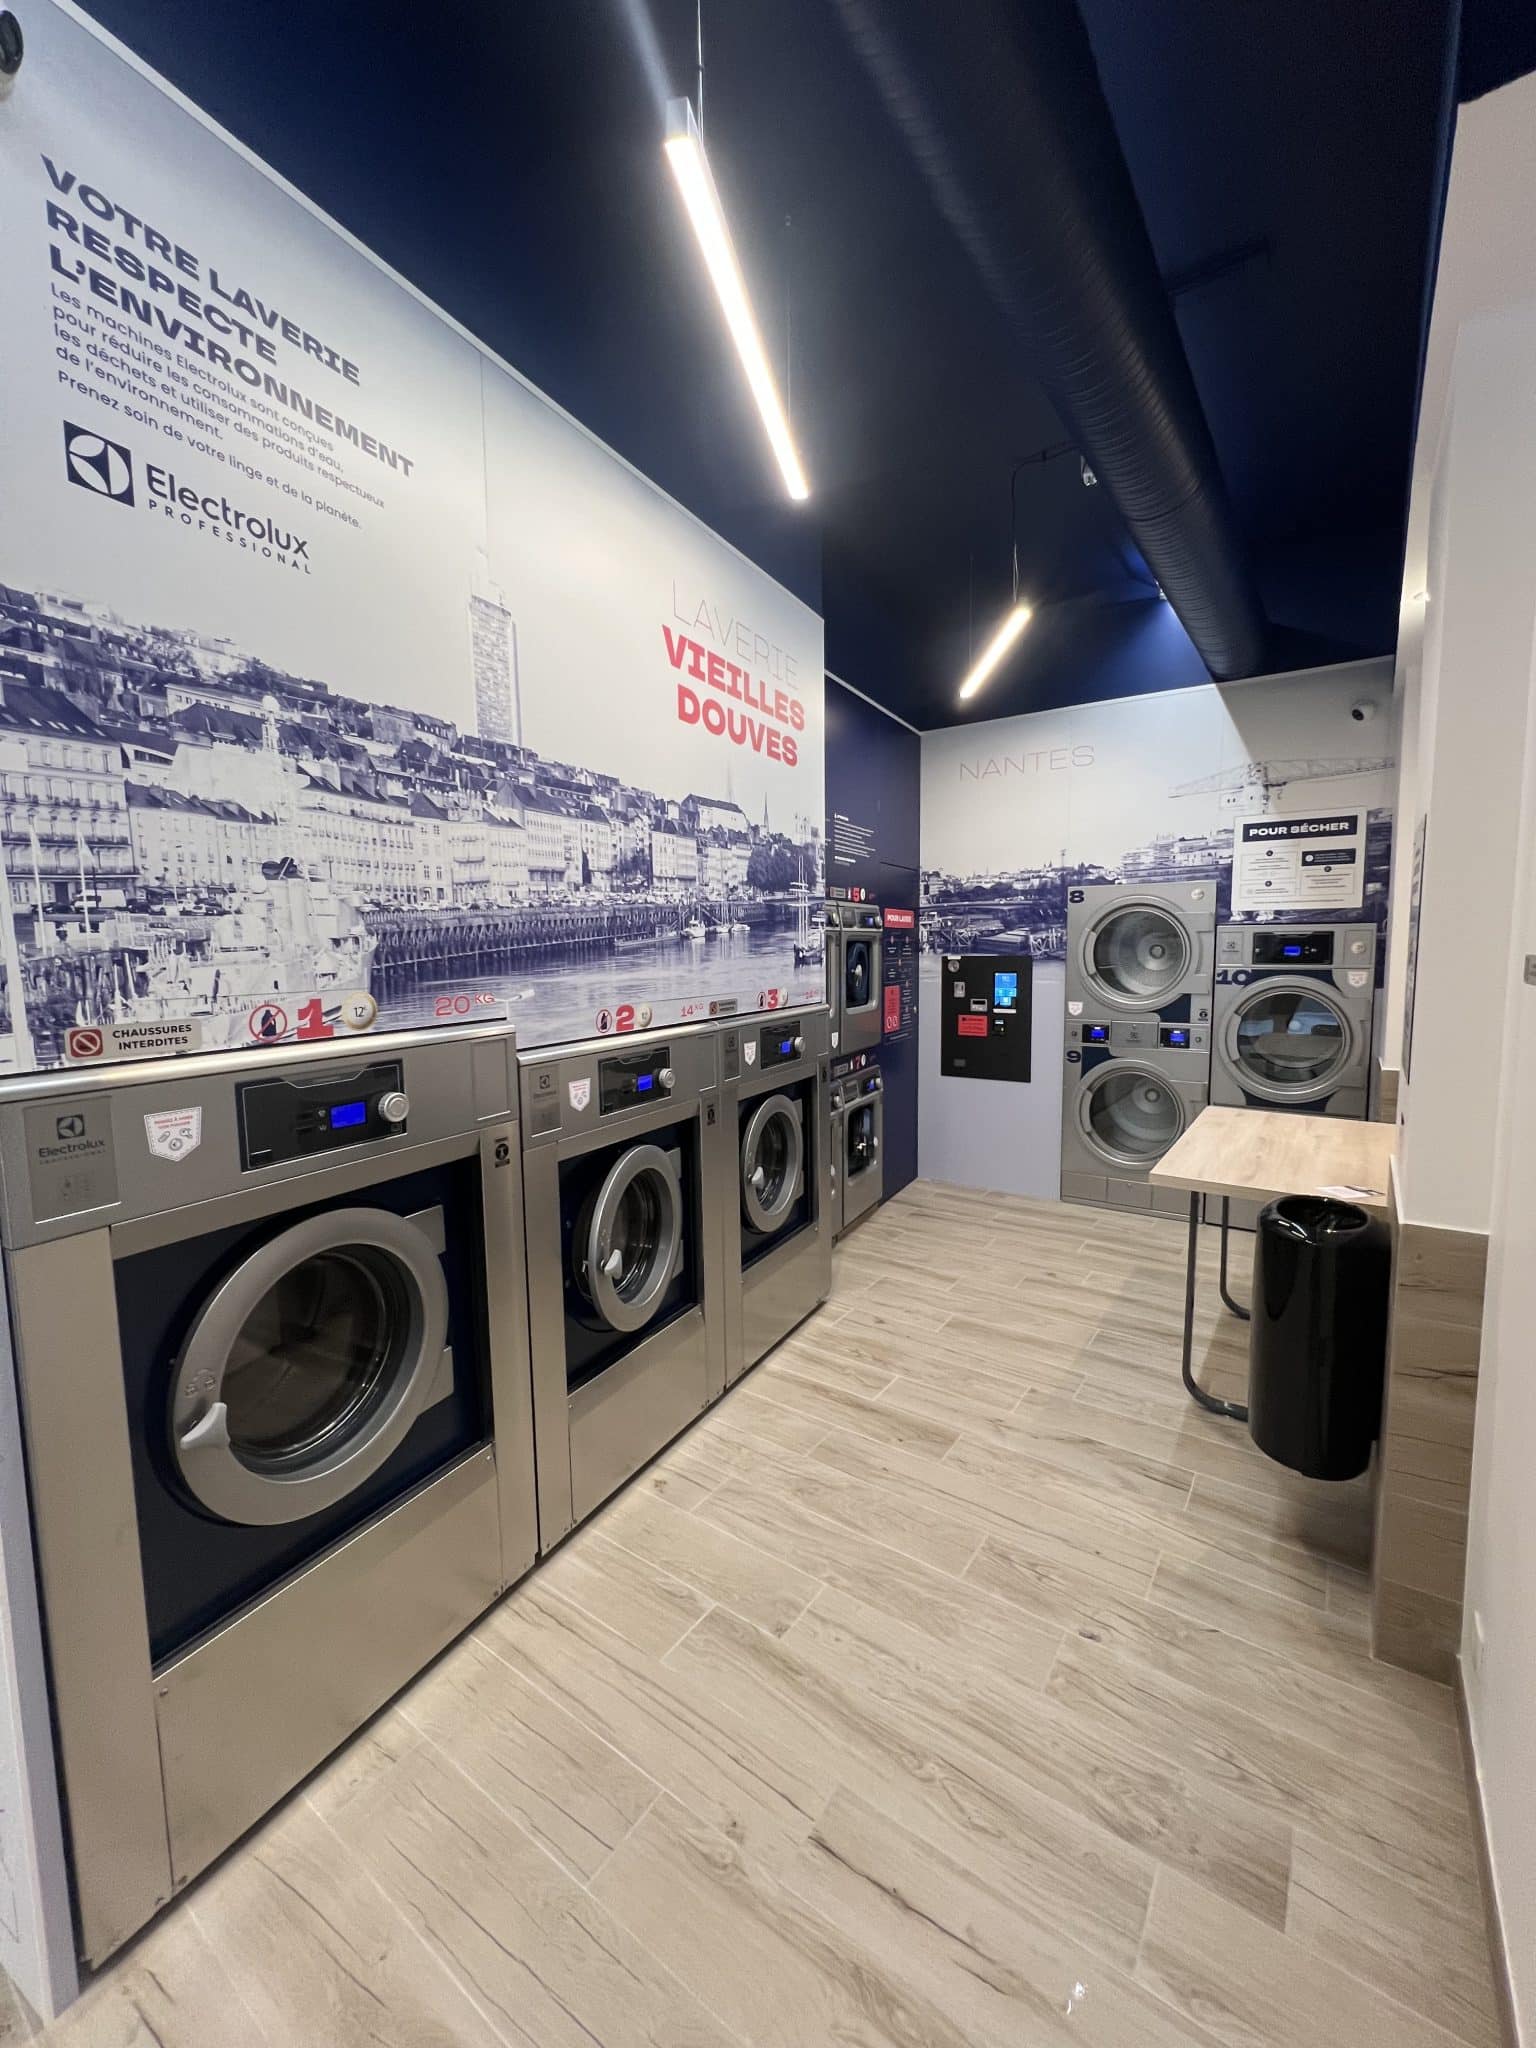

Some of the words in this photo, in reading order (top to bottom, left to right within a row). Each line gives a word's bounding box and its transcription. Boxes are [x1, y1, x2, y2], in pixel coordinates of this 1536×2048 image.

[40, 153, 199, 282] VOTRE
[209, 267, 360, 387] LAVERIE
[46, 199, 277, 366] RESPECTE
[49, 243, 414, 477] L’ENVIRONNEMENT
[51, 282, 81, 310] Les
[87, 304, 172, 361] machines
[176, 354, 247, 403] Electrolux
[250, 398, 279, 422] sont
[282, 415, 334, 452] conçues
[56, 346, 81, 367] de
[53, 306, 96, 336] pour
[102, 332, 162, 373] réduire
[167, 366, 189, 388] les
[193, 383, 305, 451] consommations
[54, 323, 81, 348] les
[86, 343, 157, 388] déchets
[161, 384, 177, 399] et
[181, 393, 230, 427] utiliser
[233, 419, 259, 442] des
[262, 437, 314, 472] produits
[317, 464, 385, 508] respectueux
[58, 370, 120, 410] Prenez
[123, 404, 158, 430] soin
[163, 423, 183, 441] de
[188, 435, 226, 462] votre
[228, 454, 263, 481] linge
[266, 474, 280, 489] et
[282, 482, 299, 498] de
[300, 490, 313, 506] la
[146, 463, 310, 560] Electrolux
[149, 498, 311, 575] PROFESSIONAL
[672, 578, 799, 690] LAVERIE
[662, 624, 805, 732] VIEILLES
[677, 683, 798, 767] DOUVES
[959, 745, 1095, 781] NANTES
[1249, 826, 1288, 837] POUR
[1290, 822, 1349, 834] SÉCHER
[1069, 890, 1085, 904] 8
[1215, 969, 1251, 986] 10
[434, 995, 471, 1017] 20
[474, 992, 496, 1004] KG
[615, 1004, 635, 1032] 2
[681, 1005, 694, 1017] 14
[767, 988, 778, 1009] 3
[112, 1024, 192, 1039] CHAUSSURES
[296, 998, 334, 1040] 1
[118, 1036, 188, 1050] INTERDITES
[1066, 1050, 1082, 1063] 9
[39, 1139, 105, 1158] Electrolux
